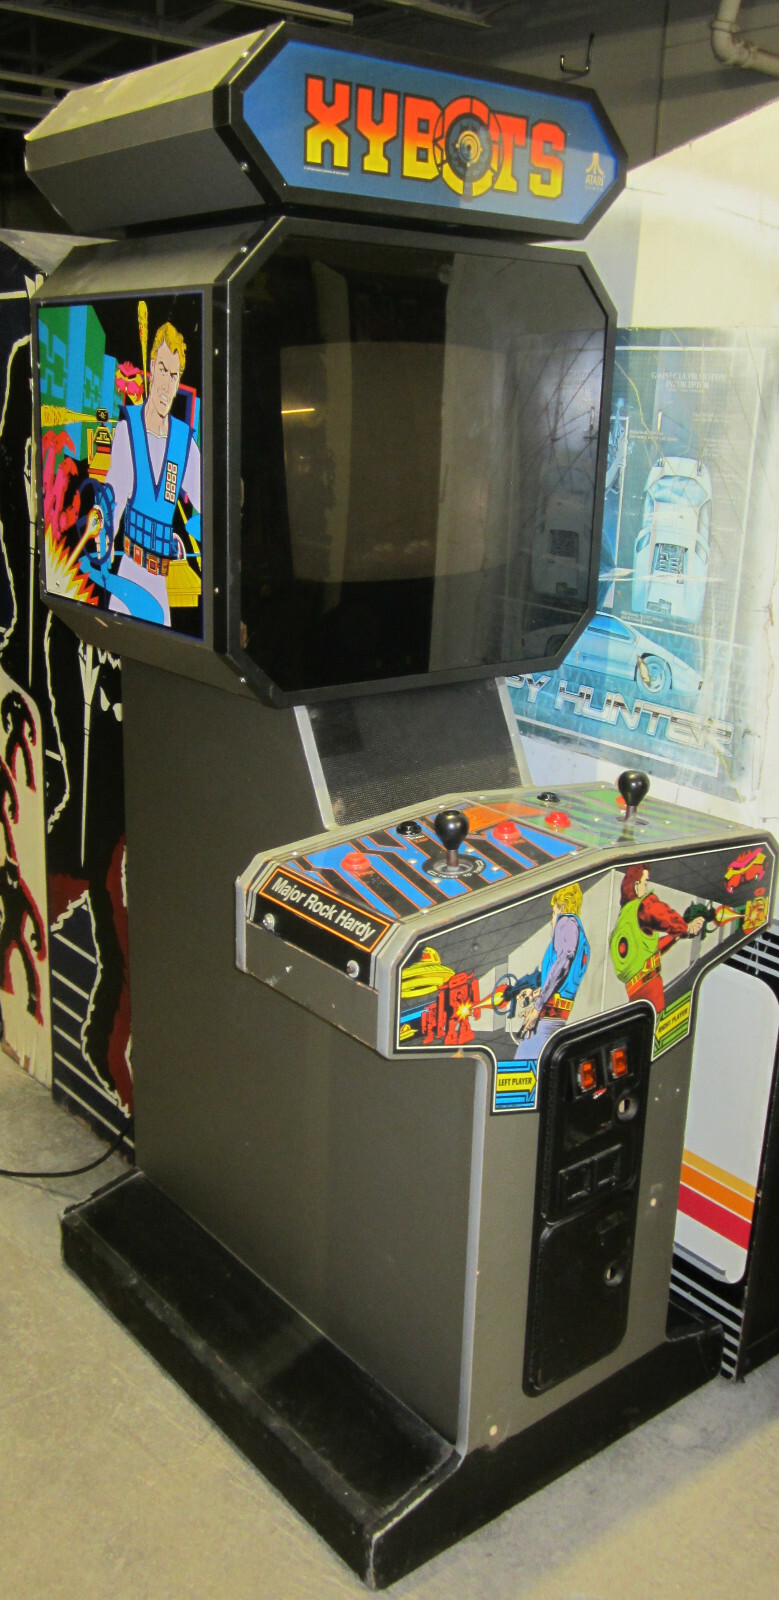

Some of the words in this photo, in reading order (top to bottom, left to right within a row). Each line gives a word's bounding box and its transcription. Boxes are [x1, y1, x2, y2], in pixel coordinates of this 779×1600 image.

[304, 74, 566, 199] XYBOTS
[585, 174, 604, 187] ATARI
[554, 680, 735, 758] HUNTER
[271, 877, 307, 902] Major
[303, 893, 338, 921] Rock
[334, 909, 376, 942] Hardy
[498, 1078, 511, 1087] LEFT
[511, 1077, 533, 1086] PLAYER
